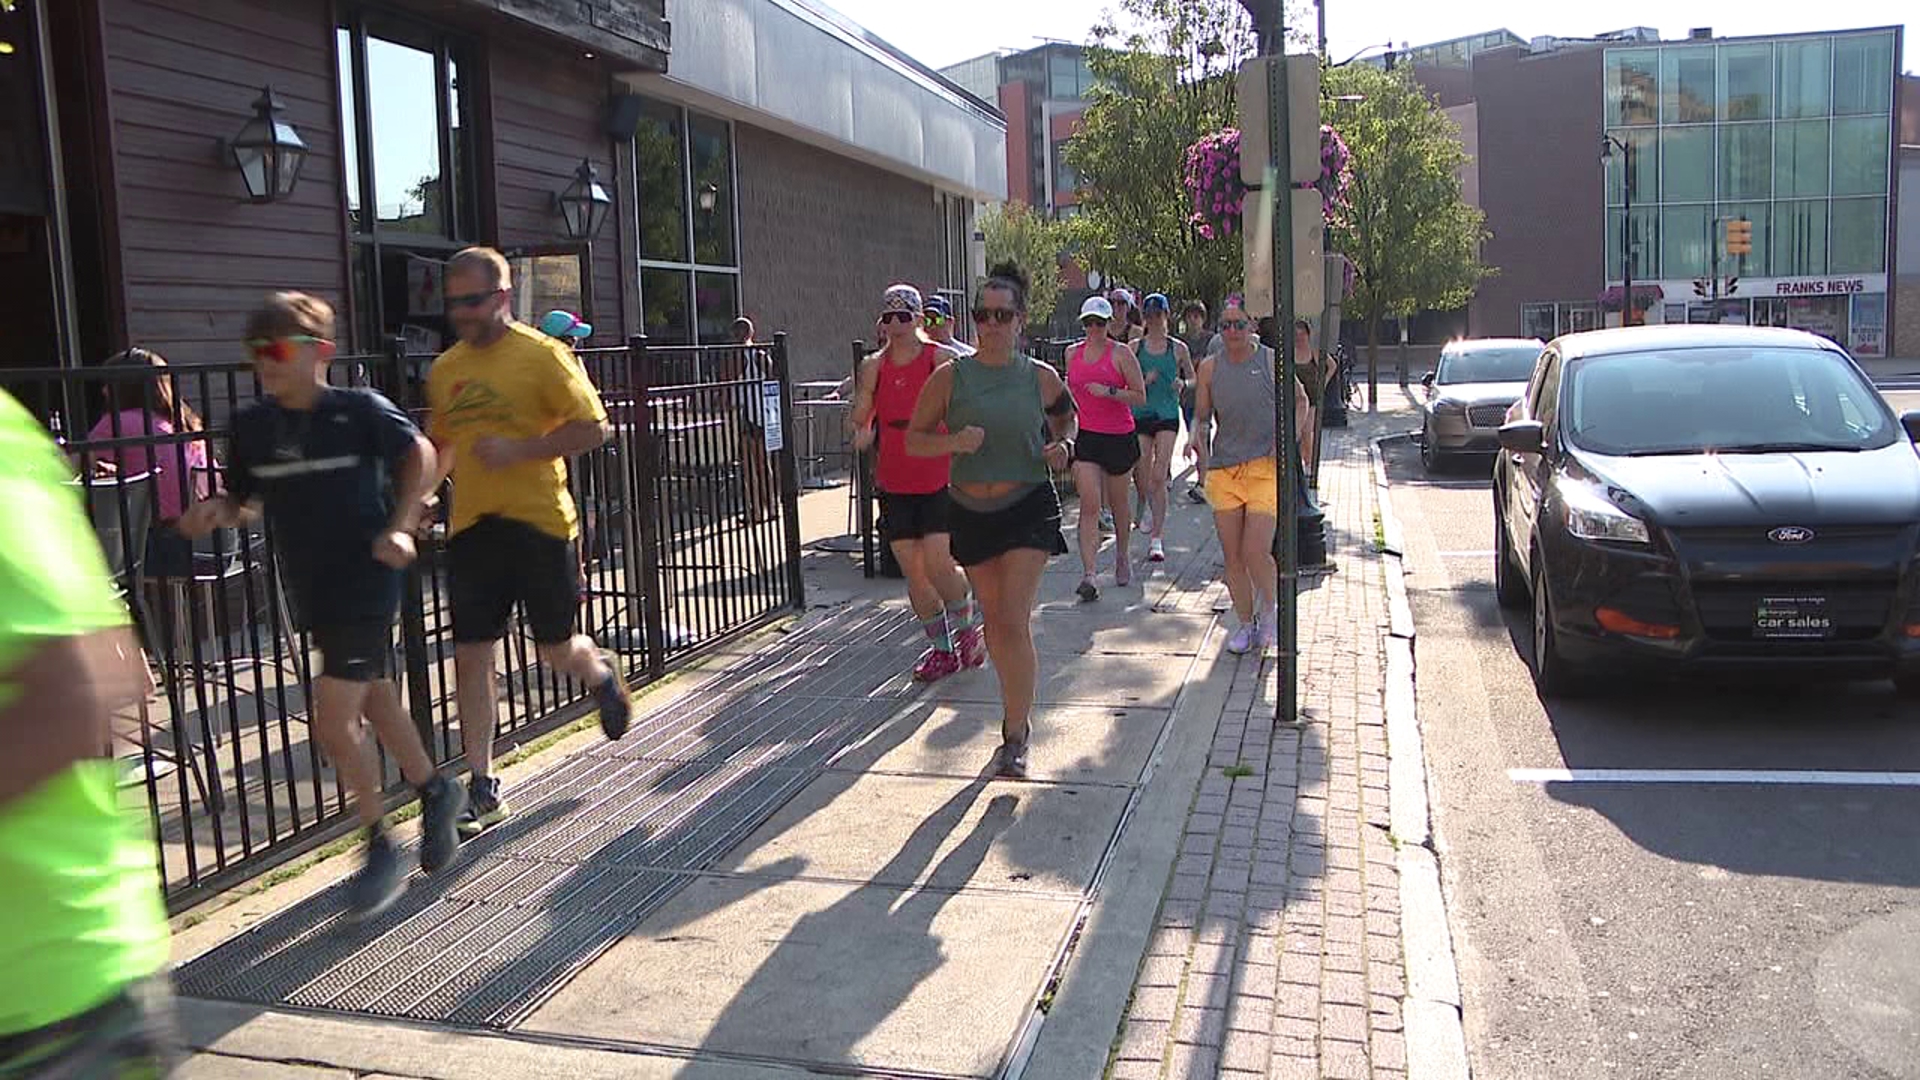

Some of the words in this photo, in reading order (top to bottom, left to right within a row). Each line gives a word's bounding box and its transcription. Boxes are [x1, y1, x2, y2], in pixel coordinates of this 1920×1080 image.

[1776, 281, 1824, 294] FRANKS
[1827, 280, 1864, 293] NEWS
[1775, 528, 1806, 541] Ford
[1757, 618, 1785, 628] car
[1787, 615, 1830, 628] sales
